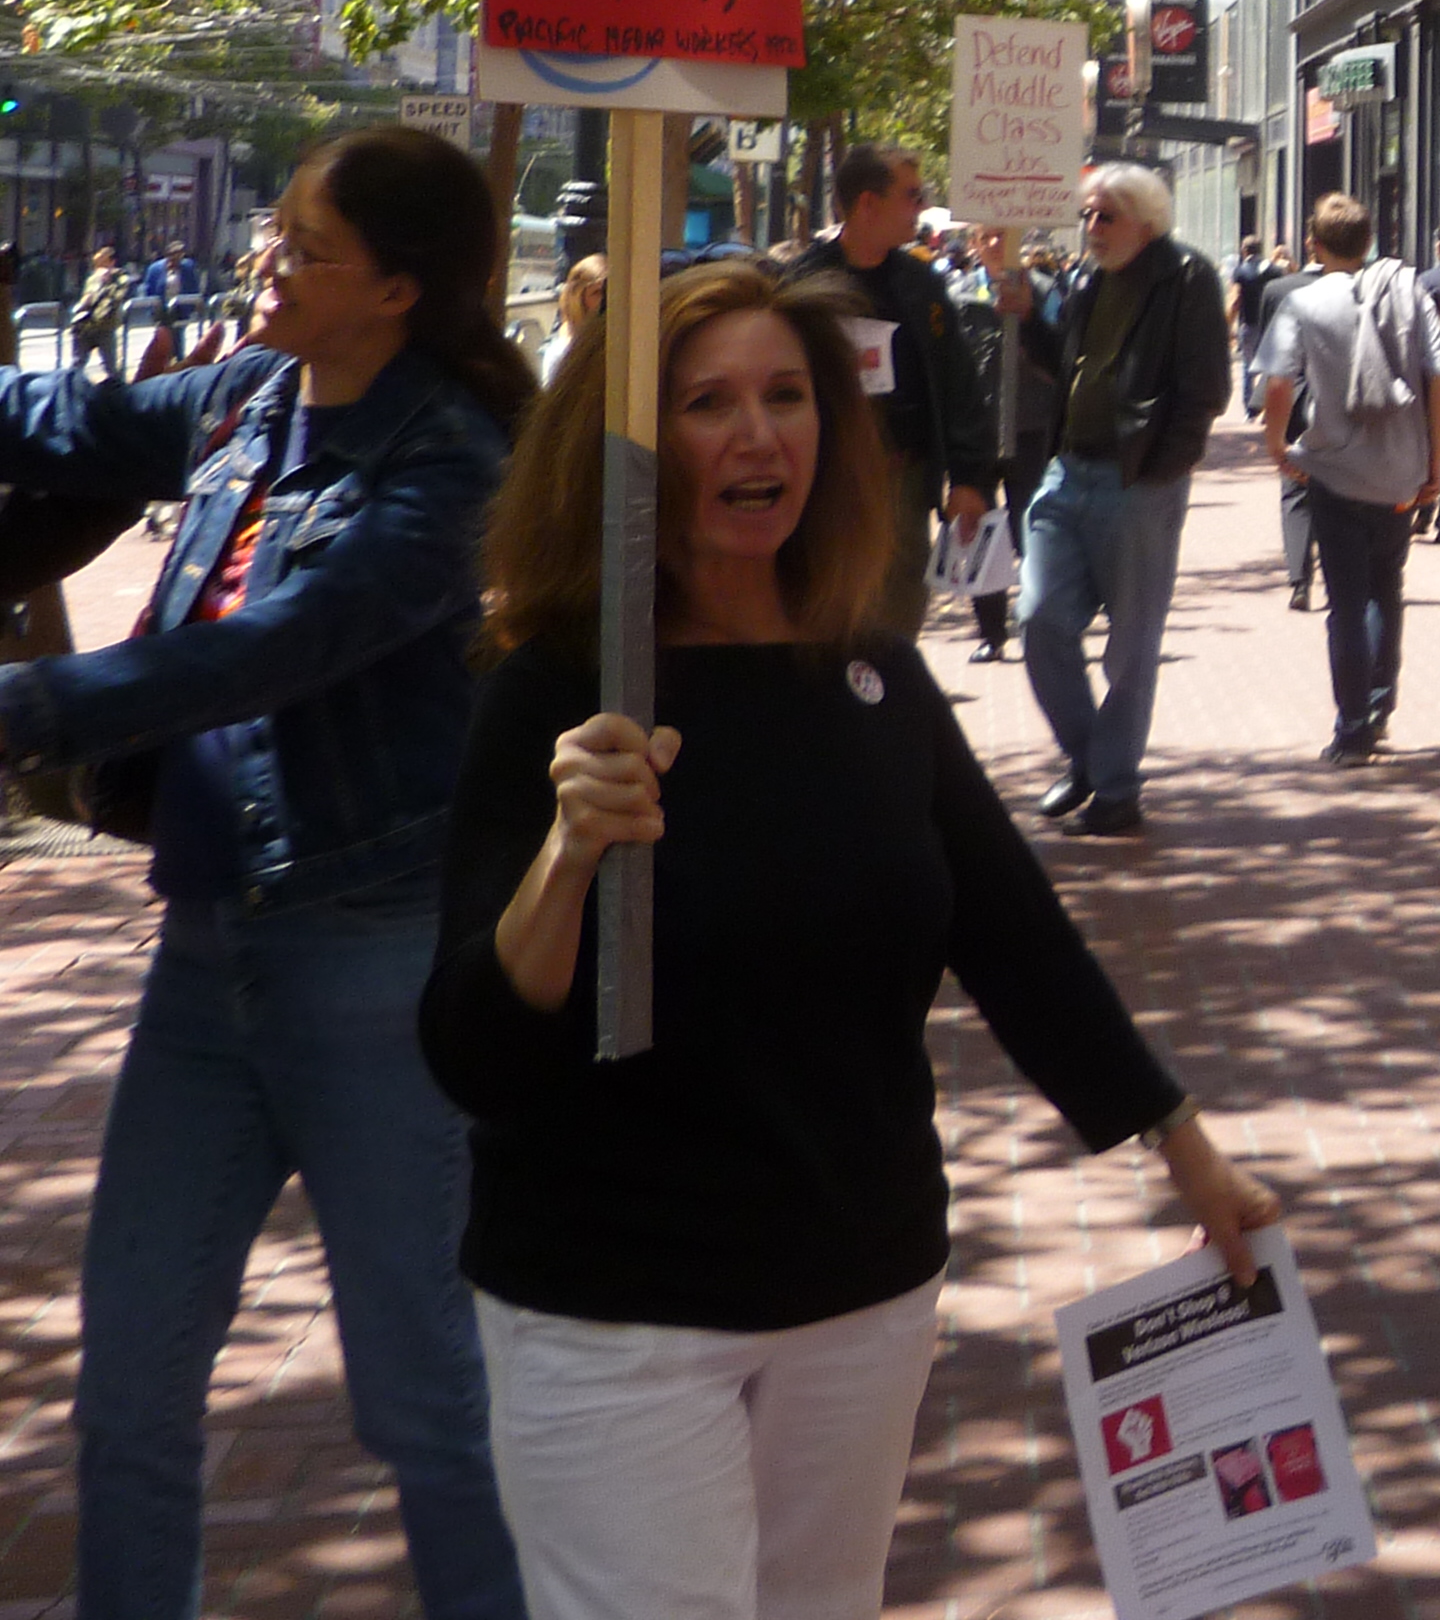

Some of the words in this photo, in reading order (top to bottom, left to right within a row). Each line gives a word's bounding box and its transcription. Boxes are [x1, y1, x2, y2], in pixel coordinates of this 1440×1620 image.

[971, 30, 1065, 70] Defend
[406, 101, 467, 118] SPEED
[969, 74, 1072, 110] Middle
[977, 109, 1064, 145] Class
